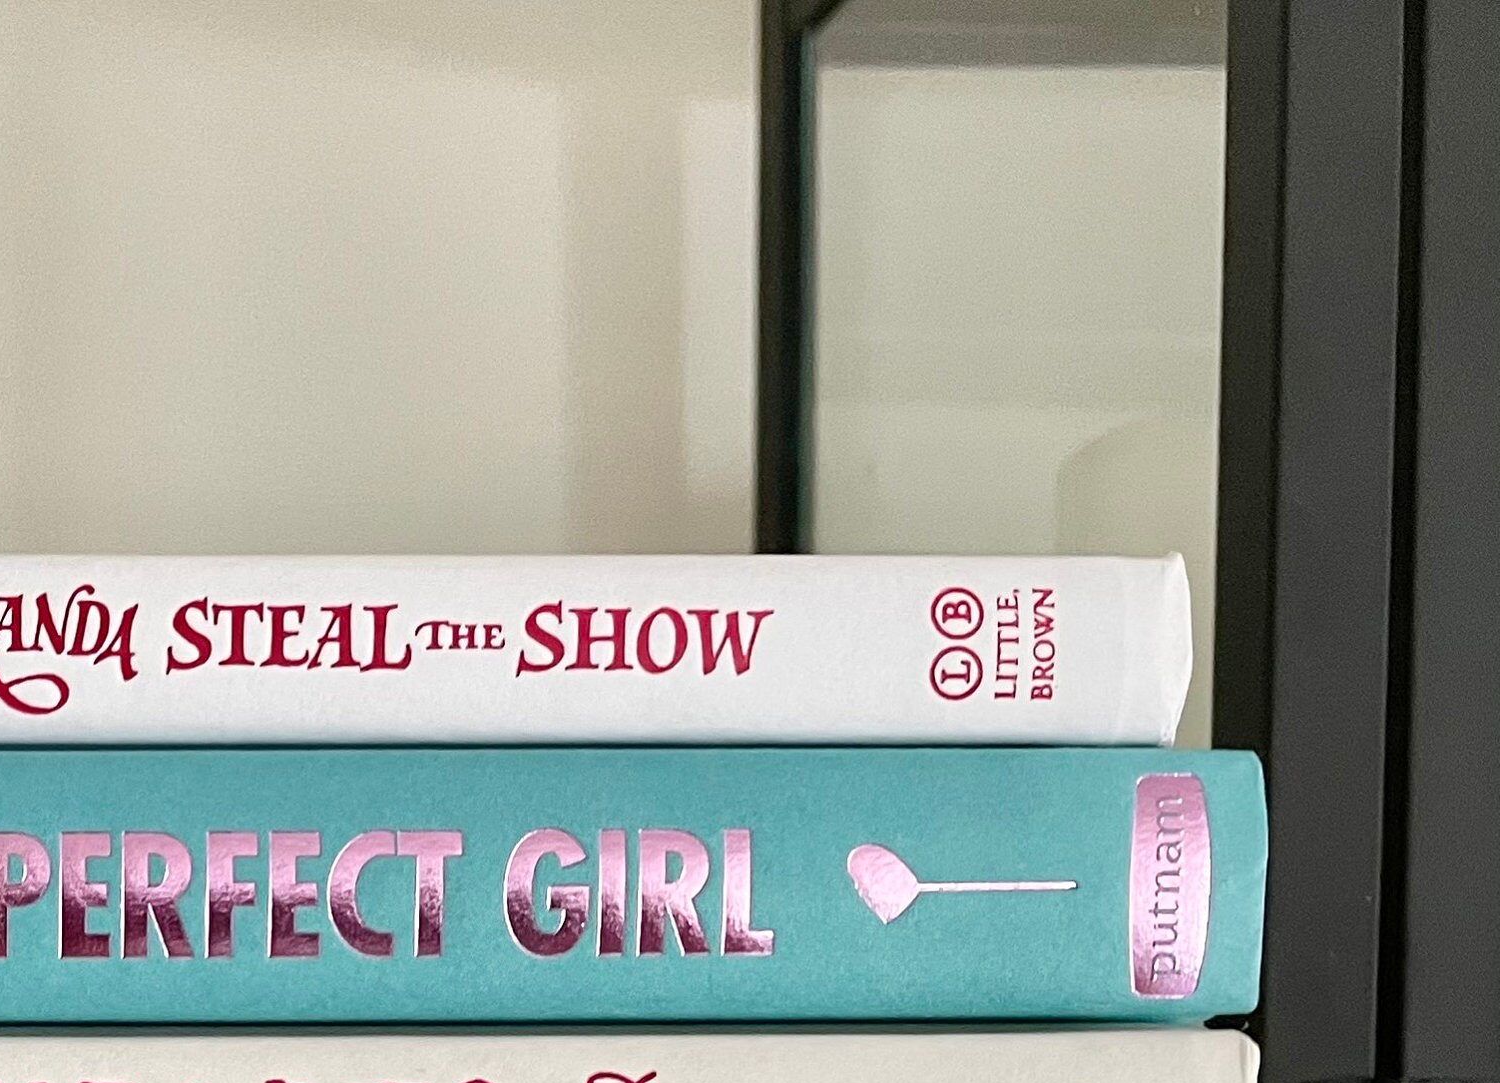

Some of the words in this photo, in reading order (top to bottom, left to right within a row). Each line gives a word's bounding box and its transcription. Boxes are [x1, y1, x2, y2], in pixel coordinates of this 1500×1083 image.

[165, 596, 413, 675] STEAL
[414, 620, 506, 651] THE
[514, 600, 775, 678] SHOW
[993, 588, 1020, 701] LITTLE,
[1030, 588, 1056, 702] BROWN
[502, 828, 775, 958] GIRL
[1148, 794, 1184, 983] putnam
